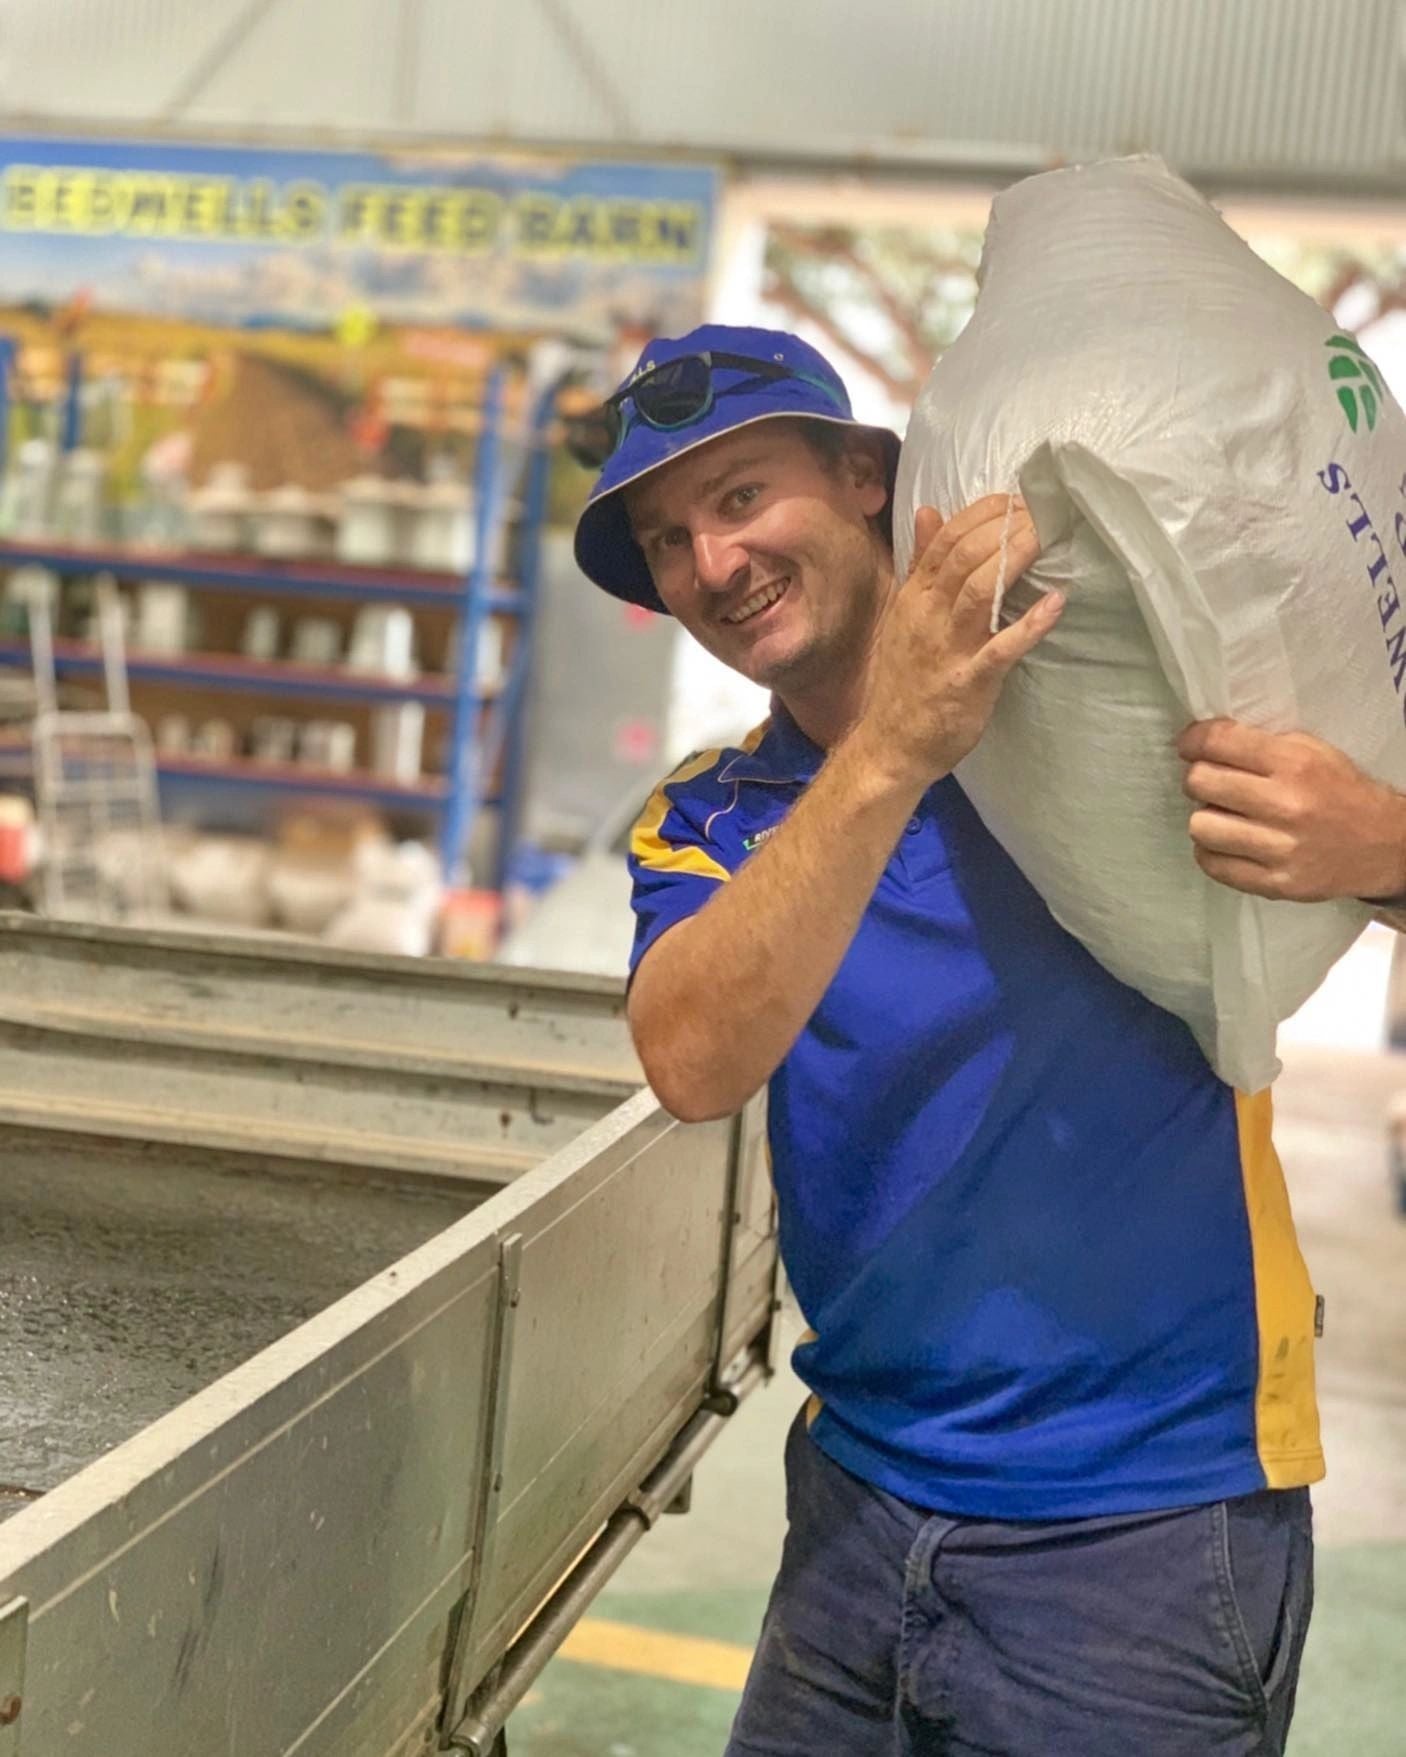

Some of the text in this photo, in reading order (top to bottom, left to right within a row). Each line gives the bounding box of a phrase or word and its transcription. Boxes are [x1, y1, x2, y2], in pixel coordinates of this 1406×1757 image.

[341, 185, 496, 252] FEED
[515, 191, 700, 261] BARN
[1317, 462, 1406, 729] WELLS
